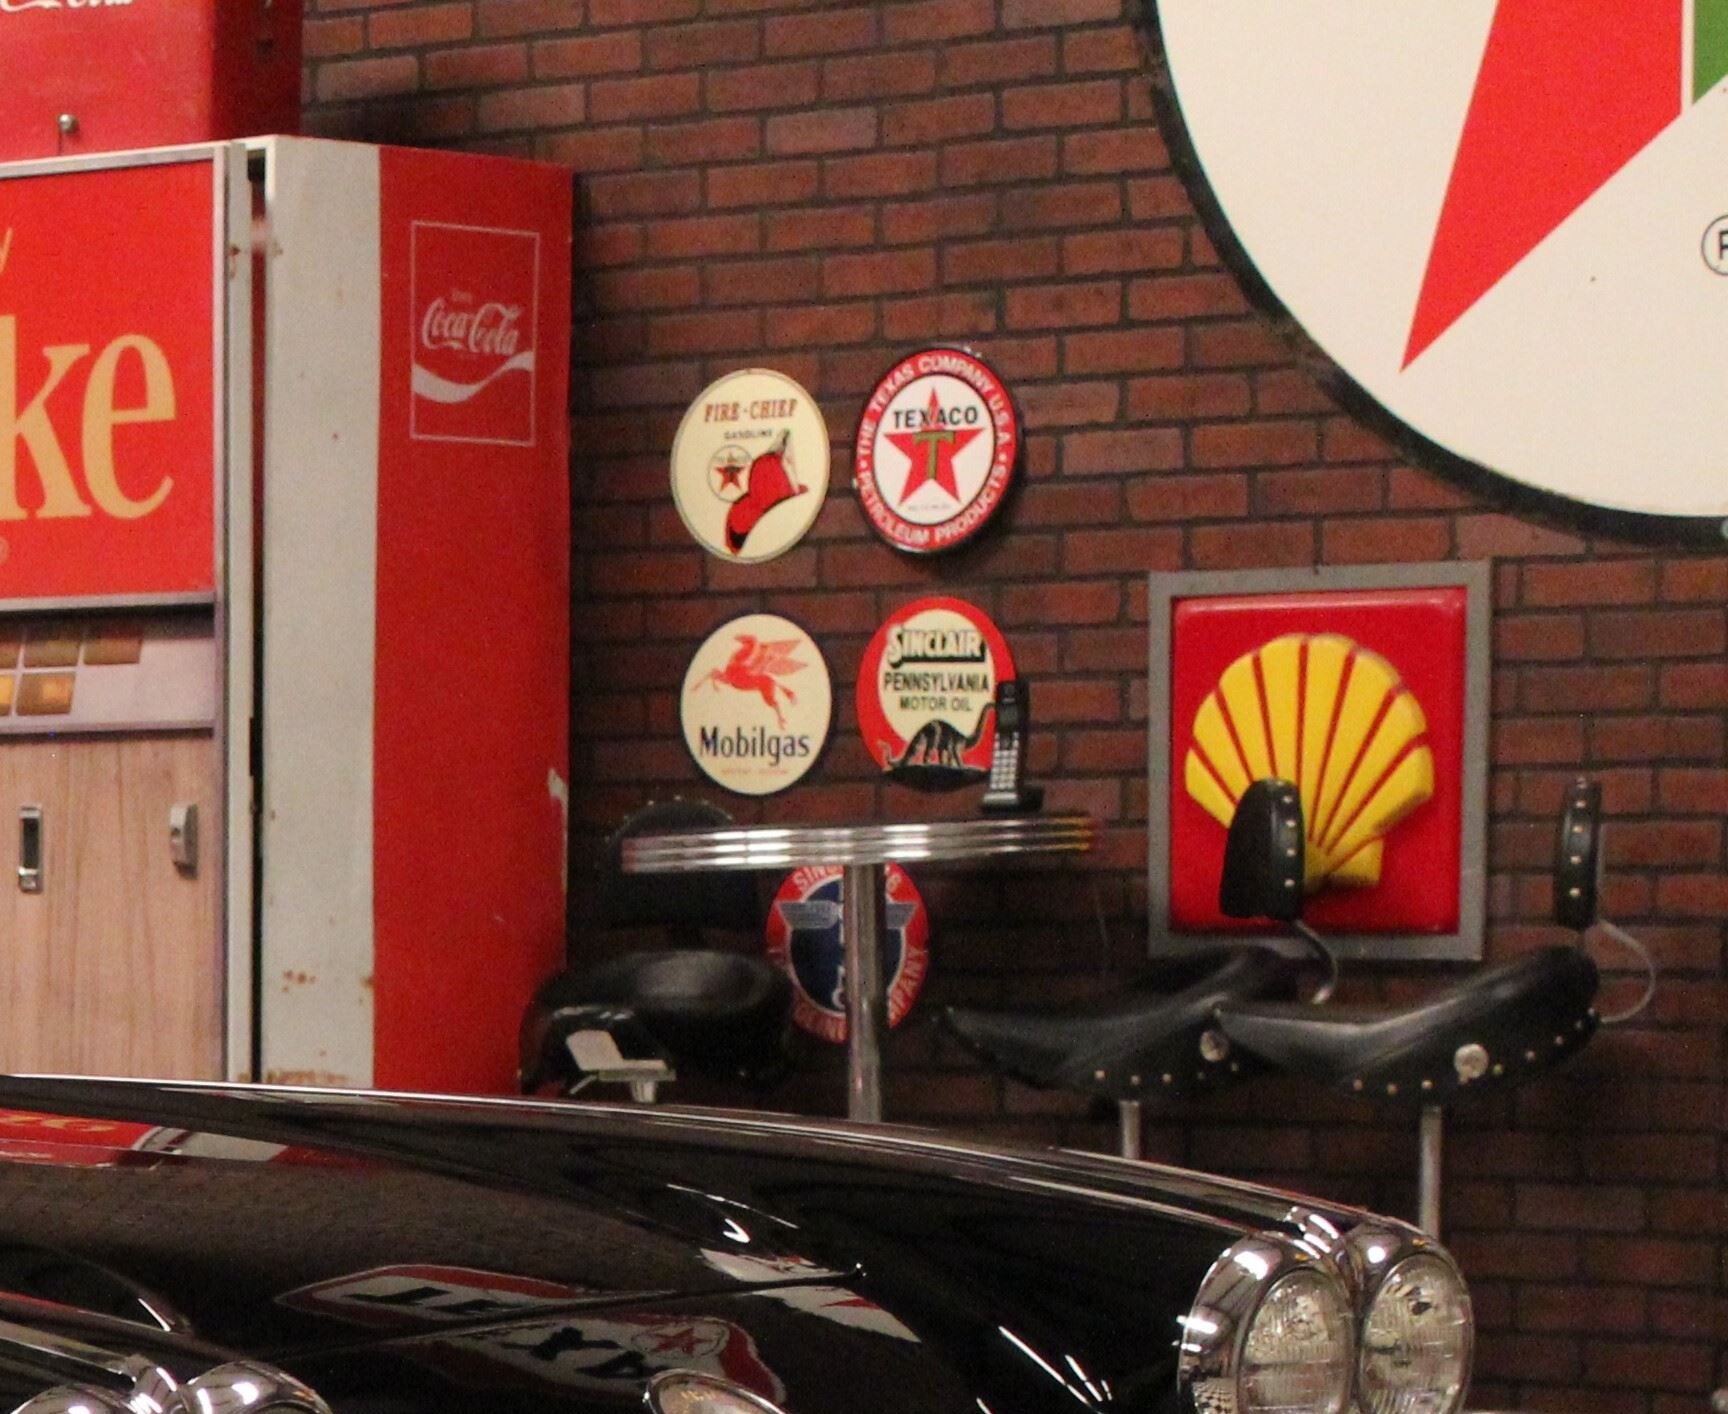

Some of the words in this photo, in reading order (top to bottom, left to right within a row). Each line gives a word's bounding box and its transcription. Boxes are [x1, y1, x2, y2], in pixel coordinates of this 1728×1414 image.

[421, 298, 523, 354] Coca-Cola
[870, 363, 915, 413] TEXAS
[918, 355, 994, 395] COMPANY
[894, 405, 979, 429] TEXACO
[857, 470, 931, 544] PETROLEUM
[934, 464, 1008, 543] PRODUCTS
[884, 672, 990, 692] PENNSYLVANIA
[900, 696, 947, 711] MOTOR
[951, 696, 973, 712] OIL
[700, 726, 810, 767] Mobilgas
